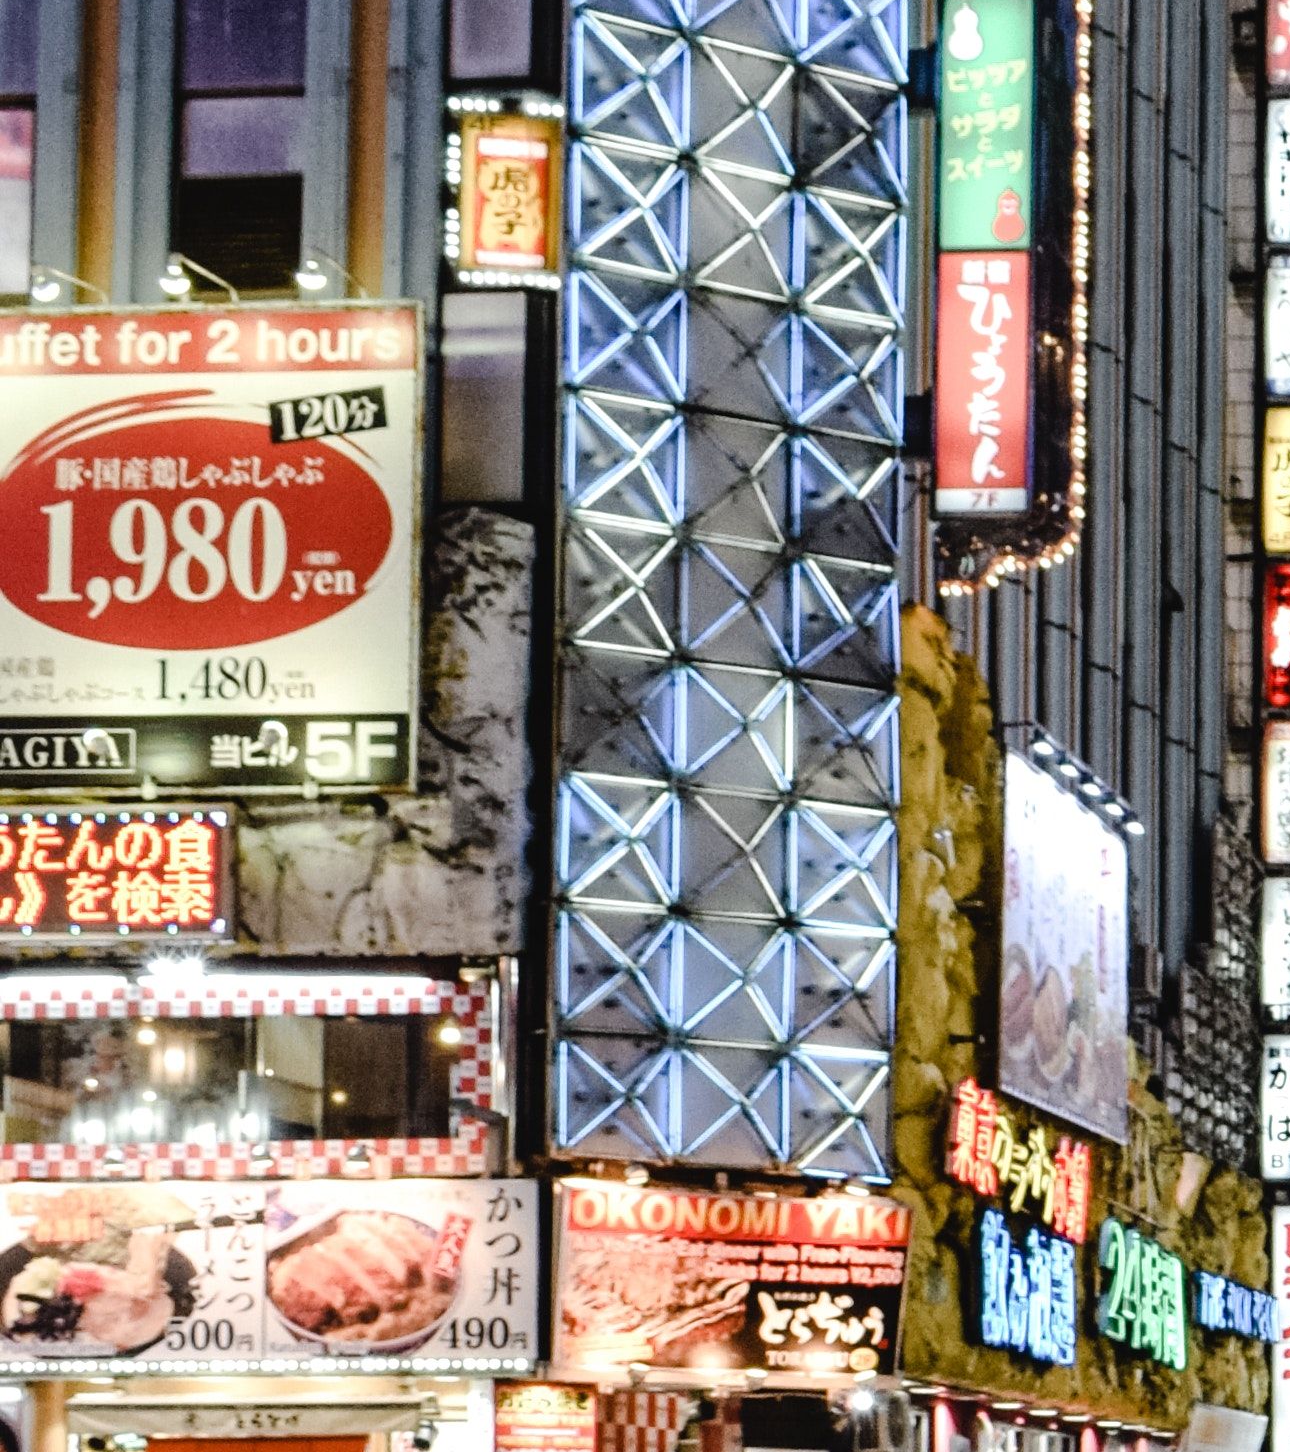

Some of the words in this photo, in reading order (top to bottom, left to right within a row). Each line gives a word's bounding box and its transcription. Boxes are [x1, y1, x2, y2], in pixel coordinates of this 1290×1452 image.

[117, 321, 192, 365] for
[206, 319, 241, 365] 2
[256, 320, 402, 363] hours
[956, 284, 1013, 485] ひょうたん
[279, 394, 380, 441] 120分
[37, 497, 287, 619] 1,980
[290, 568, 356, 601] yen
[155, 656, 267, 703] 1,480
[269, 680, 317, 704] yen
[305, 720, 399, 781] 5F
[571, 1189, 791, 1236] OKONOMI
[805, 1201, 909, 1240] YAKI
[484, 1187, 523, 1306] かつ丼
